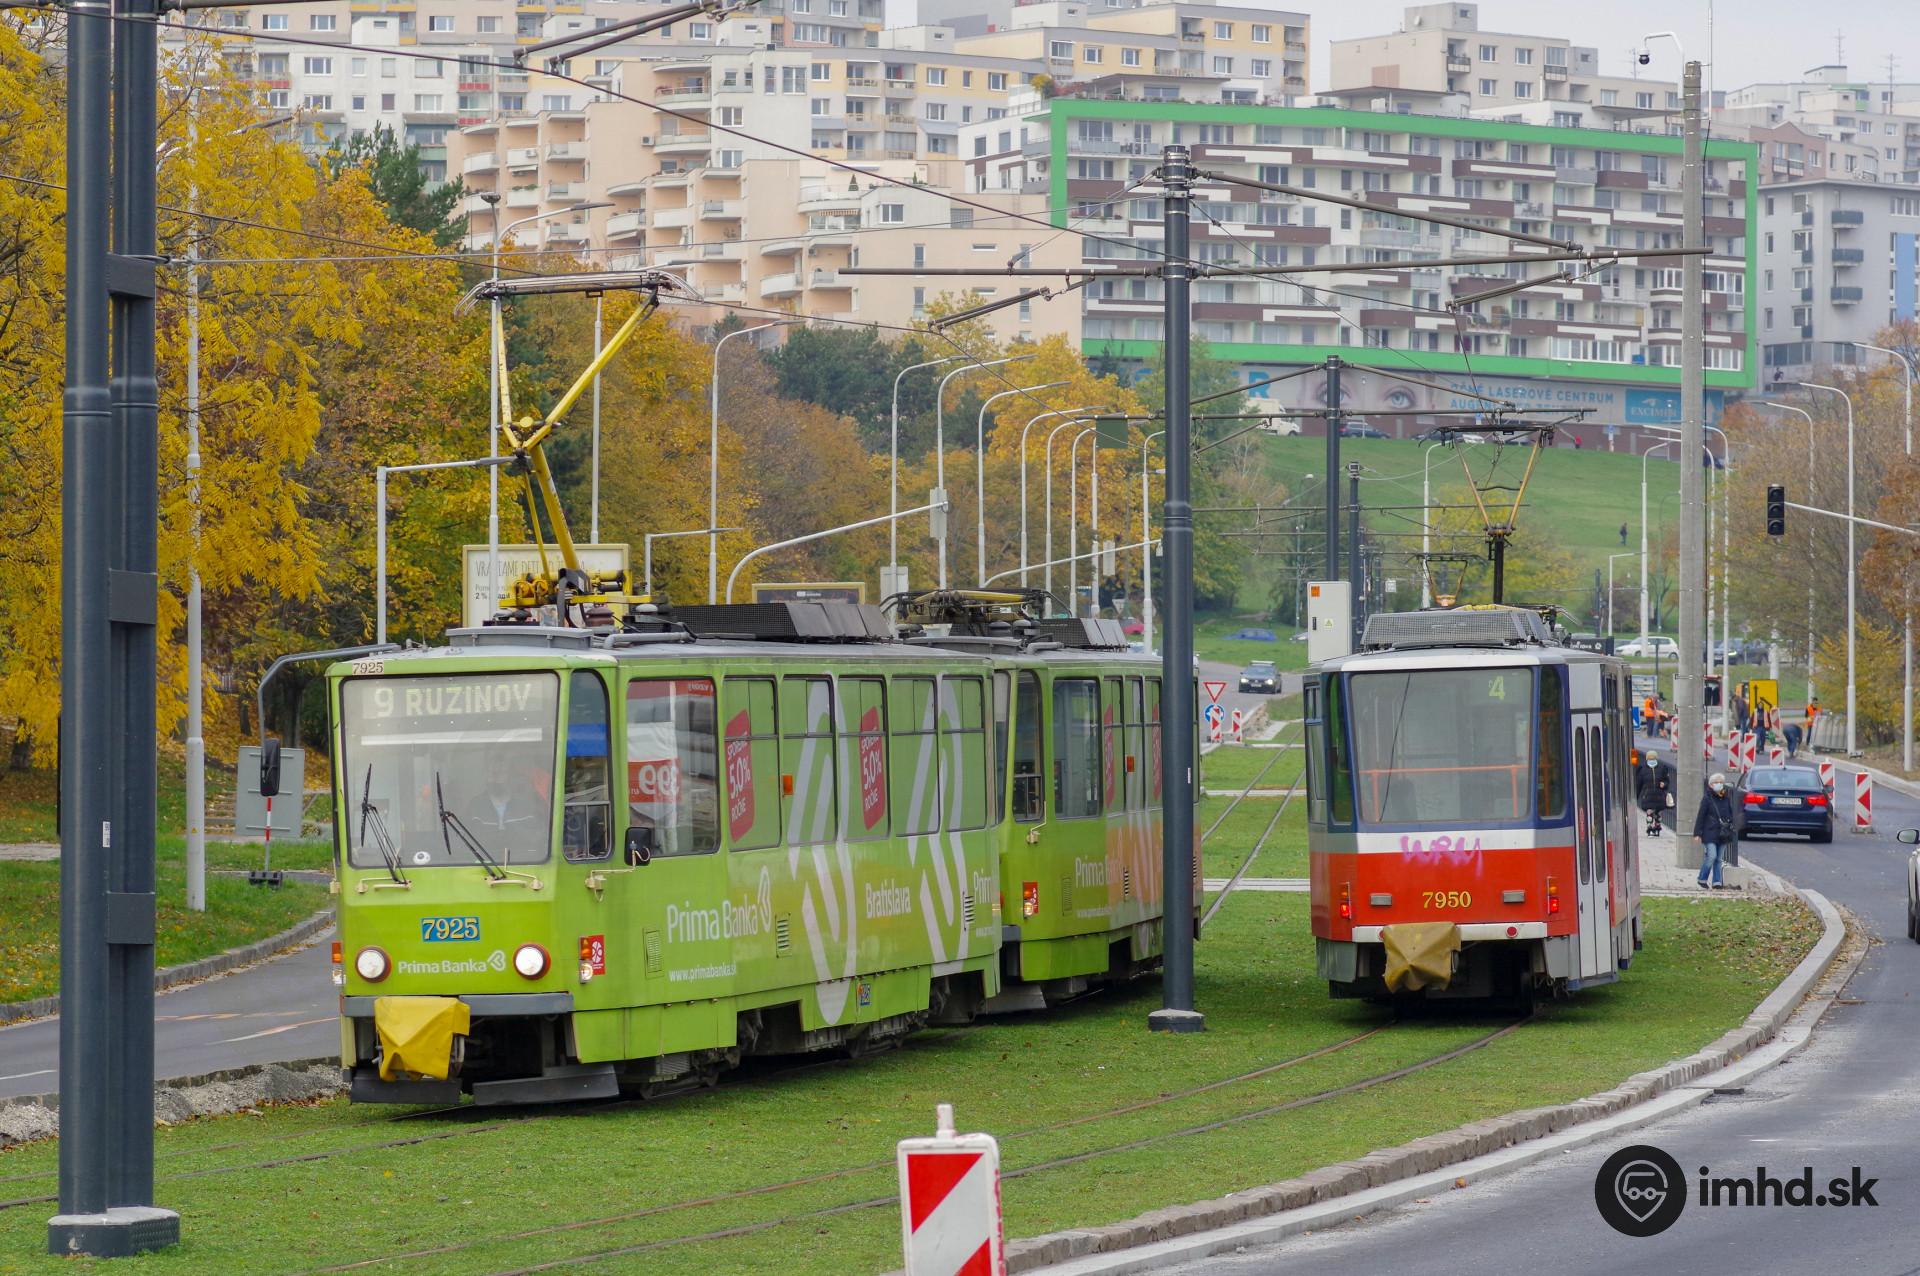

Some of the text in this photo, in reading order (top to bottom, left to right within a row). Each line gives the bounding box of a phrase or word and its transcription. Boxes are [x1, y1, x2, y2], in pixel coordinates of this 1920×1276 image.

[1556, 390, 1614, 403] CENTRUM
[353, 662, 383, 674] 7925
[1488, 676, 1505, 700] 4
[374, 688, 394, 717] 9
[1075, 854, 1105, 889] Prima
[866, 879, 911, 918] Bratislava
[1422, 891, 1472, 908] 7950
[422, 918, 479, 940] 7925
[667, 894, 758, 943] Prima Banka
[398, 959, 486, 974] Prima Banka
